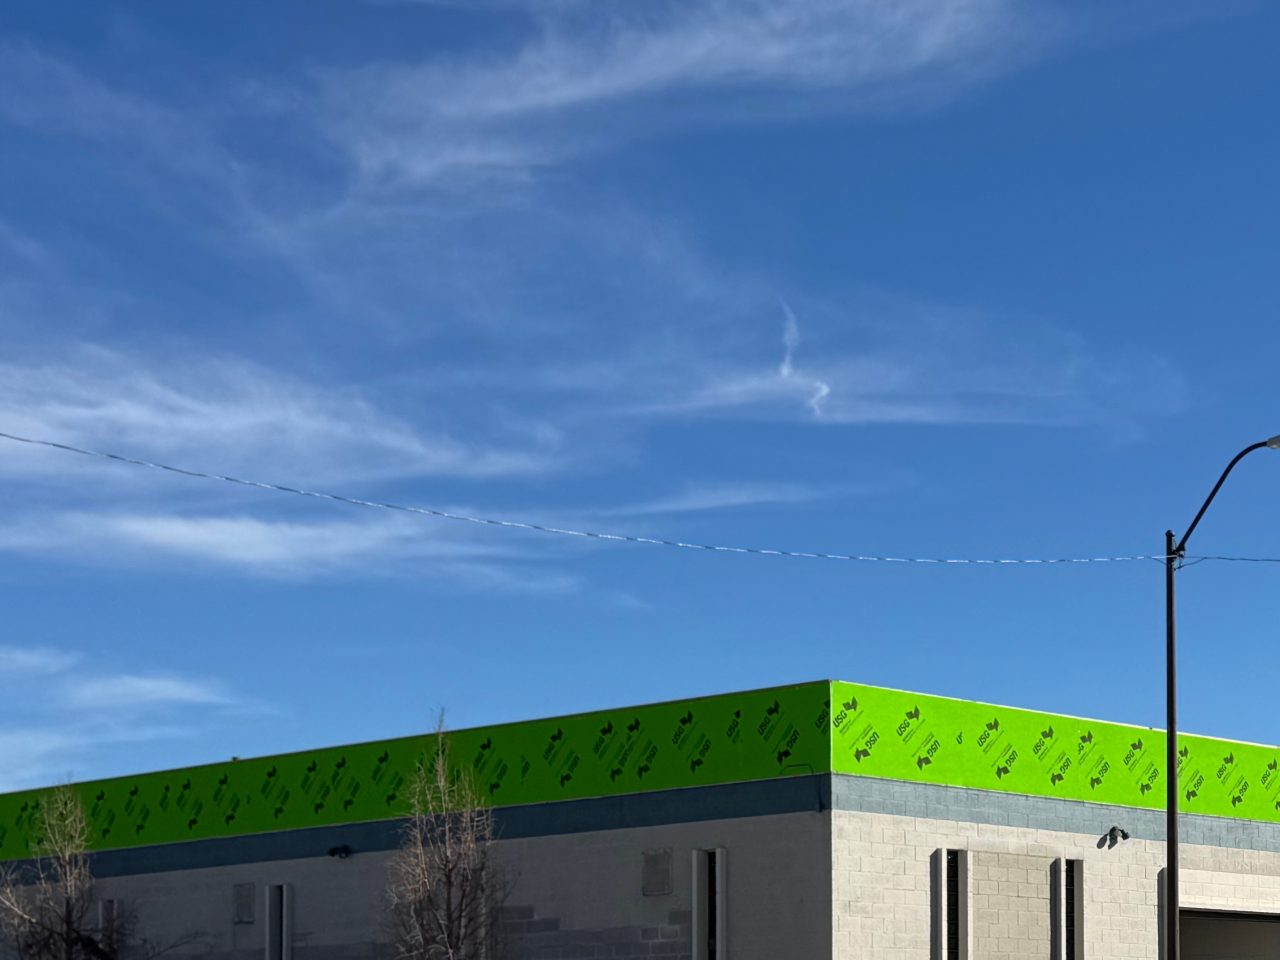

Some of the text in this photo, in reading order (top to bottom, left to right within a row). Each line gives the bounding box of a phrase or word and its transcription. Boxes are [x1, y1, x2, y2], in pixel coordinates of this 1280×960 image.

[832, 710, 848, 728] USG
[896, 719, 911, 736] USG
[865, 732, 880, 749] USG
[977, 730, 990, 747] USG
[1032, 738, 1046, 755] USG
[927, 740, 941, 757] USG
[1005, 750, 1018, 767] USG
[1060, 757, 1072, 774] USG
[1123, 749, 1136, 766] USG
[1098, 761, 1110, 778] USG
[1147, 768, 1160, 784] USG
[1216, 764, 1227, 780] USG
[1193, 775, 1205, 791] USG
[1238, 781, 1249, 797] USG
